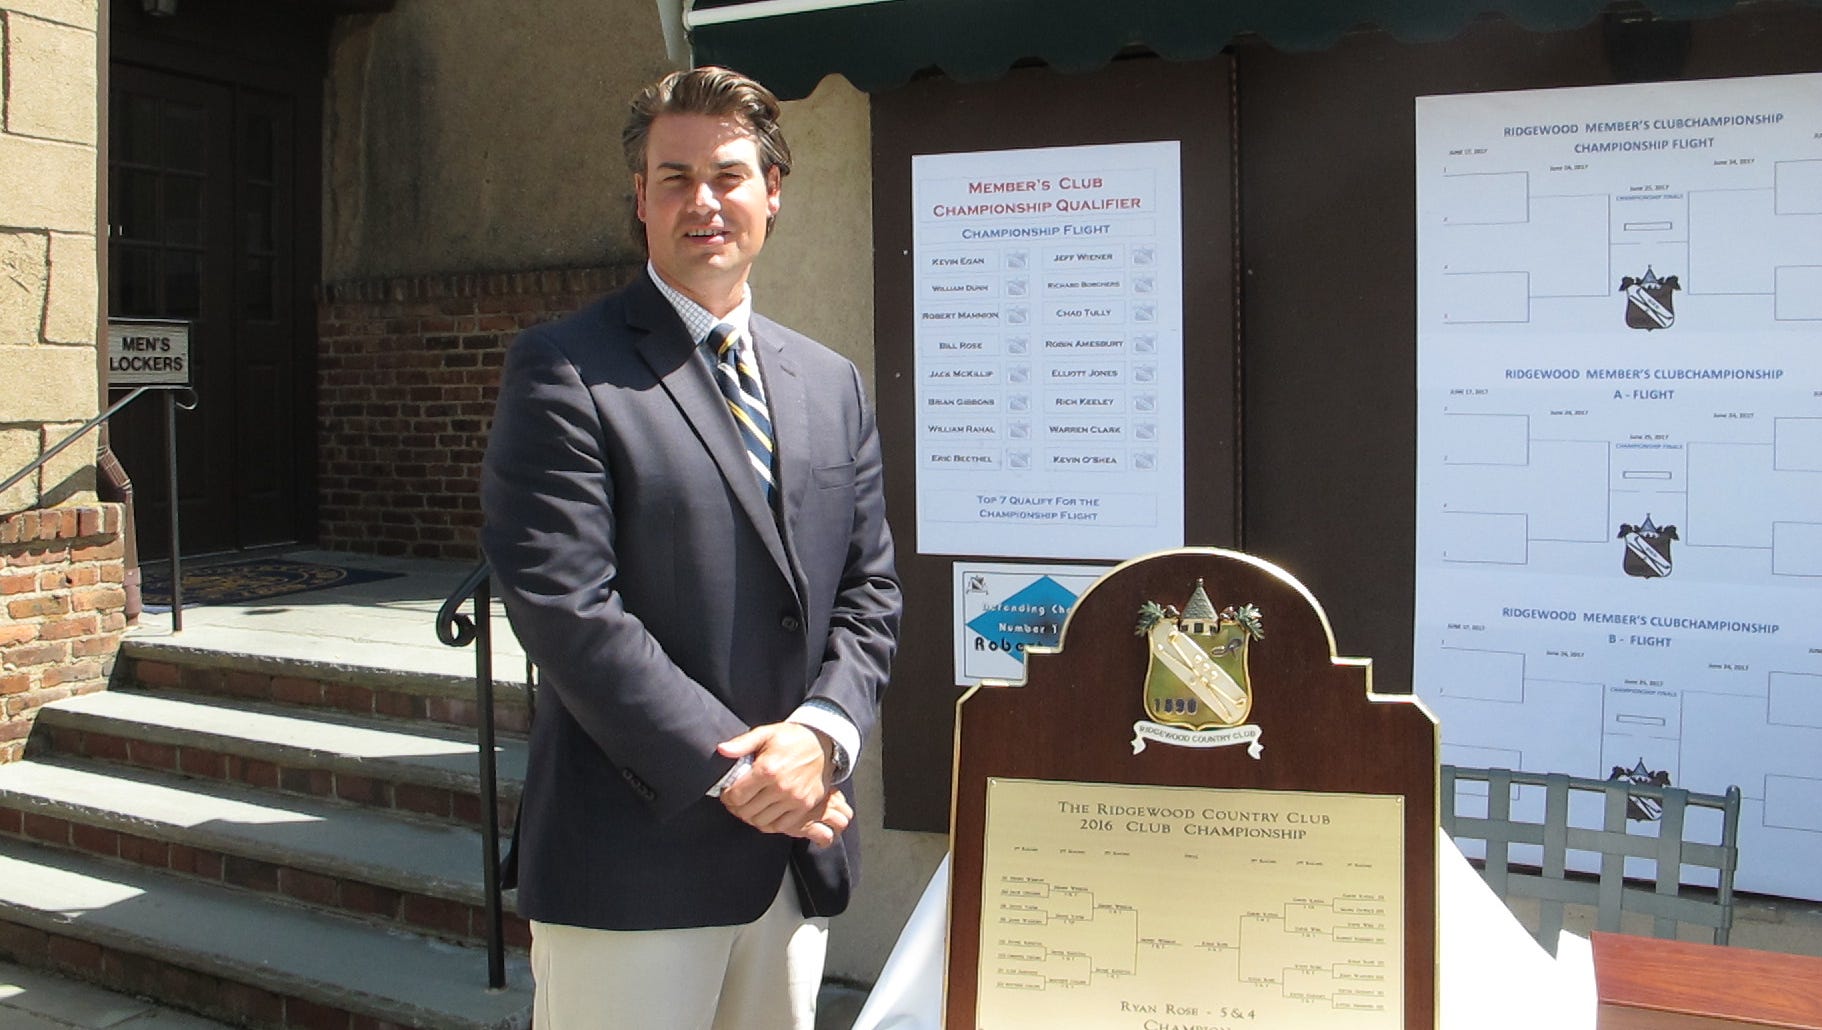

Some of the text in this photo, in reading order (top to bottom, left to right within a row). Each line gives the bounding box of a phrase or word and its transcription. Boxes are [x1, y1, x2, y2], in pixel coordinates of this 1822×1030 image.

[1504, 112, 1784, 138] RIDGEWOOD MEMBER'S CLUBCHAMPIONSHIP
[1574, 137, 1714, 154] CHAMPIONSHIP FLIGHT
[968, 176, 1102, 194] MEMBER'S CLUB
[933, 198, 1141, 218] CHAMPIONSHIP QUALIFIER
[962, 224, 1111, 240] CHAMPIONSHIP FLIGHT
[932, 258, 958, 266] KEVIN
[932, 284, 964, 292] WILLIAM
[1056, 308, 1112, 318] CHAD TULLY
[122, 336, 170, 352] MEN'S
[939, 342, 982, 350] BILL ROSE
[1045, 340, 1074, 348] ROBIN
[110, 356, 183, 372] LOCKERS
[1052, 370, 1118, 378] ELLIOTT JONES
[1504, 368, 1784, 380] RIDGEWOOD MEMBER'S CLUBCHAMPIONSHIP
[1613, 389, 1623, 400] A
[1633, 389, 1674, 400] FLIGHT
[1055, 398, 1114, 406] RICH KEELEY
[928, 425, 965, 434] WILLIAM
[1049, 426, 1121, 434] WARREN CLARK
[1053, 456, 1081, 464] KEVIN
[977, 495, 998, 505] TOP
[1009, 496, 1052, 506] QUALIFY
[1056, 497, 1076, 506] FOR
[1080, 498, 1100, 507] THE
[979, 509, 1098, 520] CHAMPIONSHIP FLIGHT
[1502, 607, 1780, 634] RIDGEWOOD MEMBER'S CLUBCHAMPIONSHIP
[998, 623, 1046, 634] Number
[1608, 634, 1616, 644] B
[1630, 636, 1672, 648] FLIGHT
[1192, 735, 1231, 744] COUNTRY
[1233, 730, 1256, 740] CLUB
[1058, 801, 1331, 825] THE RIDGEWOOD COUNTRY CLUB
[1080, 818, 1307, 840] 2016 CLUB CHAMPIONSHIP
[1120, 1000, 1157, 1014] RYAN
[1166, 1004, 1198, 1016] ROSE
